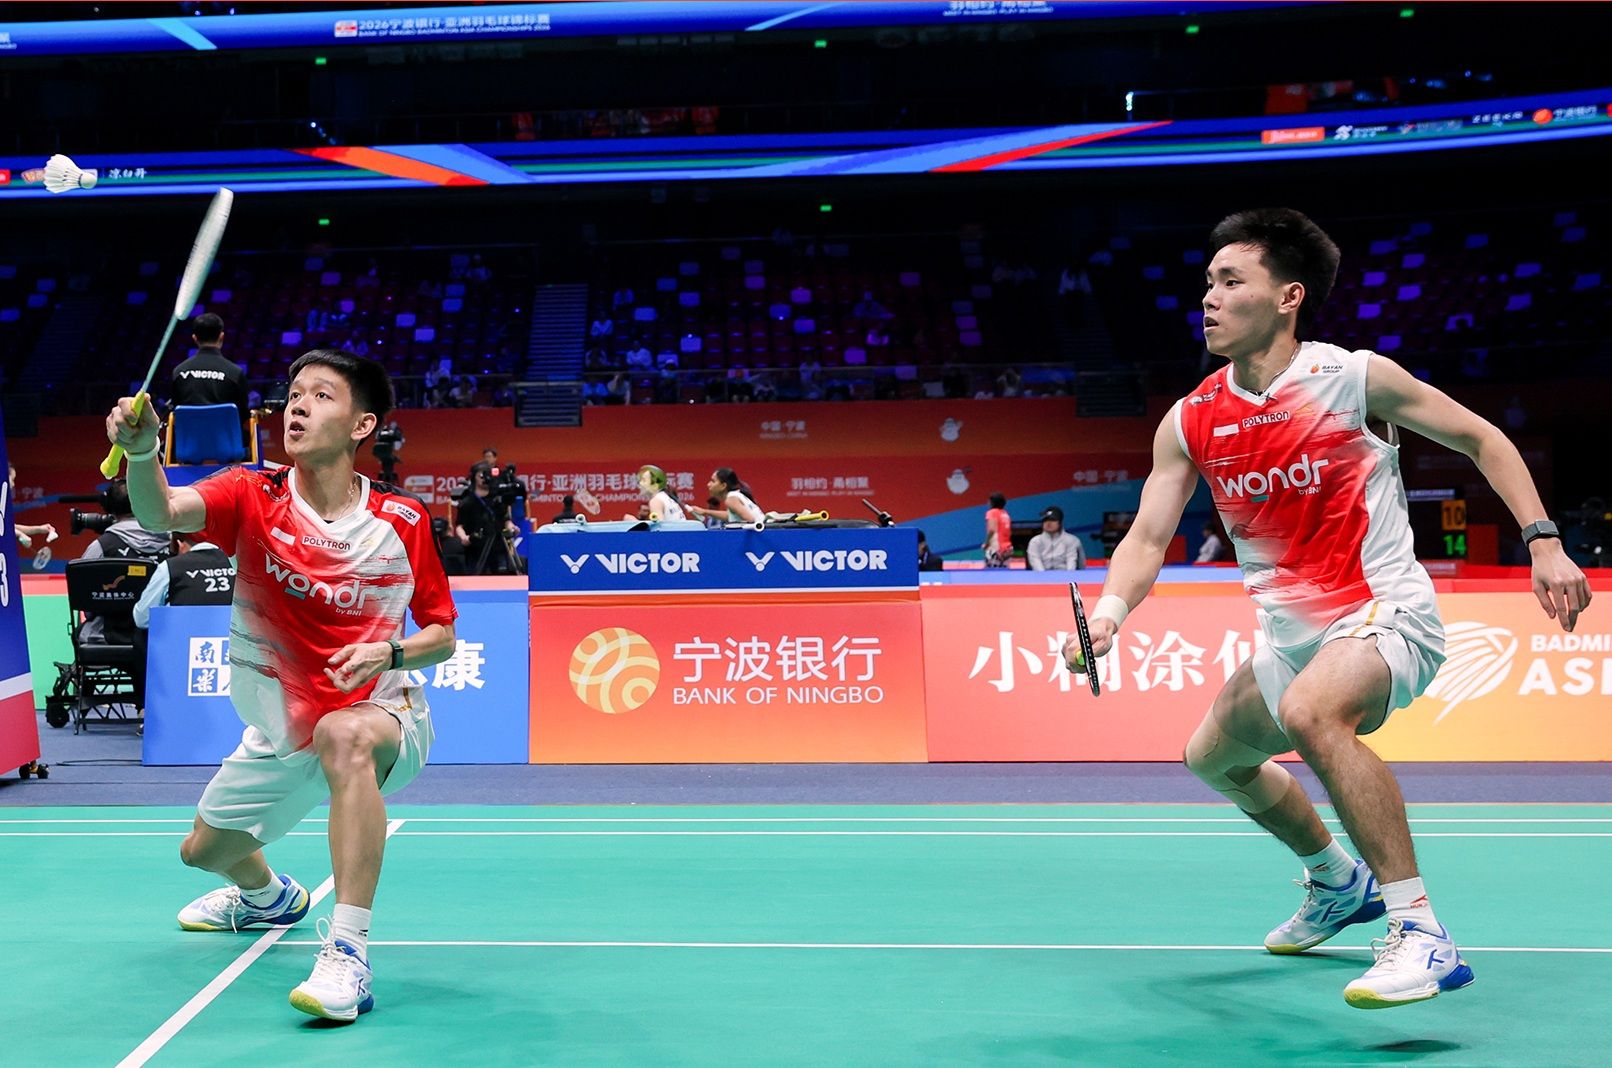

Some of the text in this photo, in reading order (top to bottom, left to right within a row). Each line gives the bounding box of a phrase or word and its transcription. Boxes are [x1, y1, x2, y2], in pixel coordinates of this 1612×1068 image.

[190, 370, 226, 381] VICTOR
[1244, 411, 1289, 428] POLYTRON
[1216, 453, 1329, 499] wondr
[303, 536, 351, 550] POLYTRON
[1443, 534, 1467, 556] 14
[594, 552, 700, 574] VICTOR
[780, 549, 888, 571] VICTOR
[199, 567, 237, 577] VICTO
[265, 553, 371, 609] wondr
[204, 576, 231, 593] 23
[335, 607, 362, 617] by BNI
[1531, 633, 1612, 652] BADMI
[673, 635, 882, 683] 宁波银行
[673, 685, 884, 704] BANK OF NINGBO
